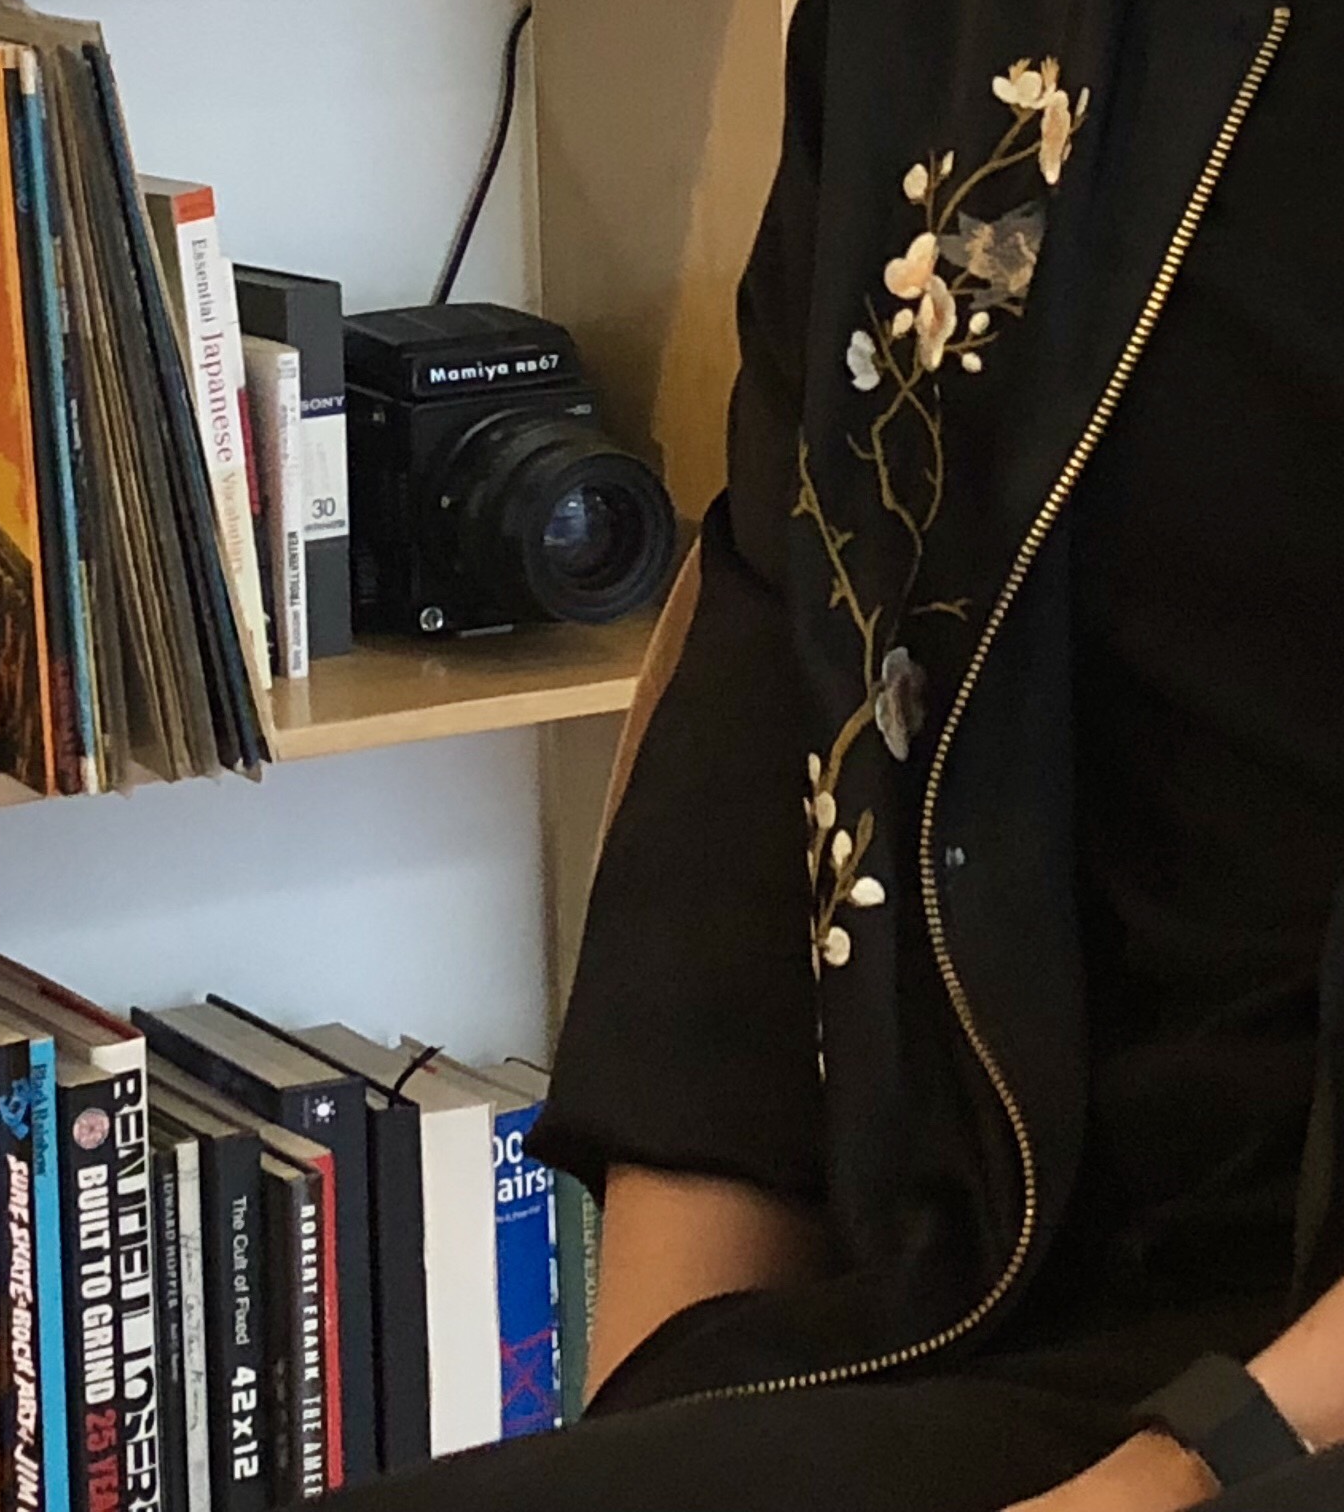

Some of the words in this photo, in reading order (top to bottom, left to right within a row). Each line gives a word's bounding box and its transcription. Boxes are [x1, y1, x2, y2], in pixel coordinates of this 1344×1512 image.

[192, 238, 216, 323] Essential
[199, 330, 235, 464] Japanese
[300, 395, 346, 411] SONY
[429, 361, 509, 384] Mamiya
[312, 496, 337, 519] 30
[6, 1153, 30, 1220] SURF
[77, 1163, 111, 1251] BUILT
[162, 1172, 179, 1241] EDWARD
[231, 1195, 248, 1230] The
[497, 1166, 547, 1203] airs
[8, 1221, 33, 1300] SKATE
[81, 1254, 112, 1300] TO
[166, 1245, 181, 1309] HOPPER
[233, 1233, 249, 1270] Cult
[299, 1203, 318, 1294] ROBERT
[233, 1274, 250, 1293] of
[10, 1307, 36, 1377] ROCK
[233, 1296, 250, 1346] Fixed
[302, 1304, 320, 1382] FRANK
[81, 1303, 115, 1405] GRIND
[84, 1408, 117, 1452] 25
[230, 1365, 260, 1481] 42x12
[301, 1394, 322, 1434] THE
[14, 1443, 39, 1507] JIM
